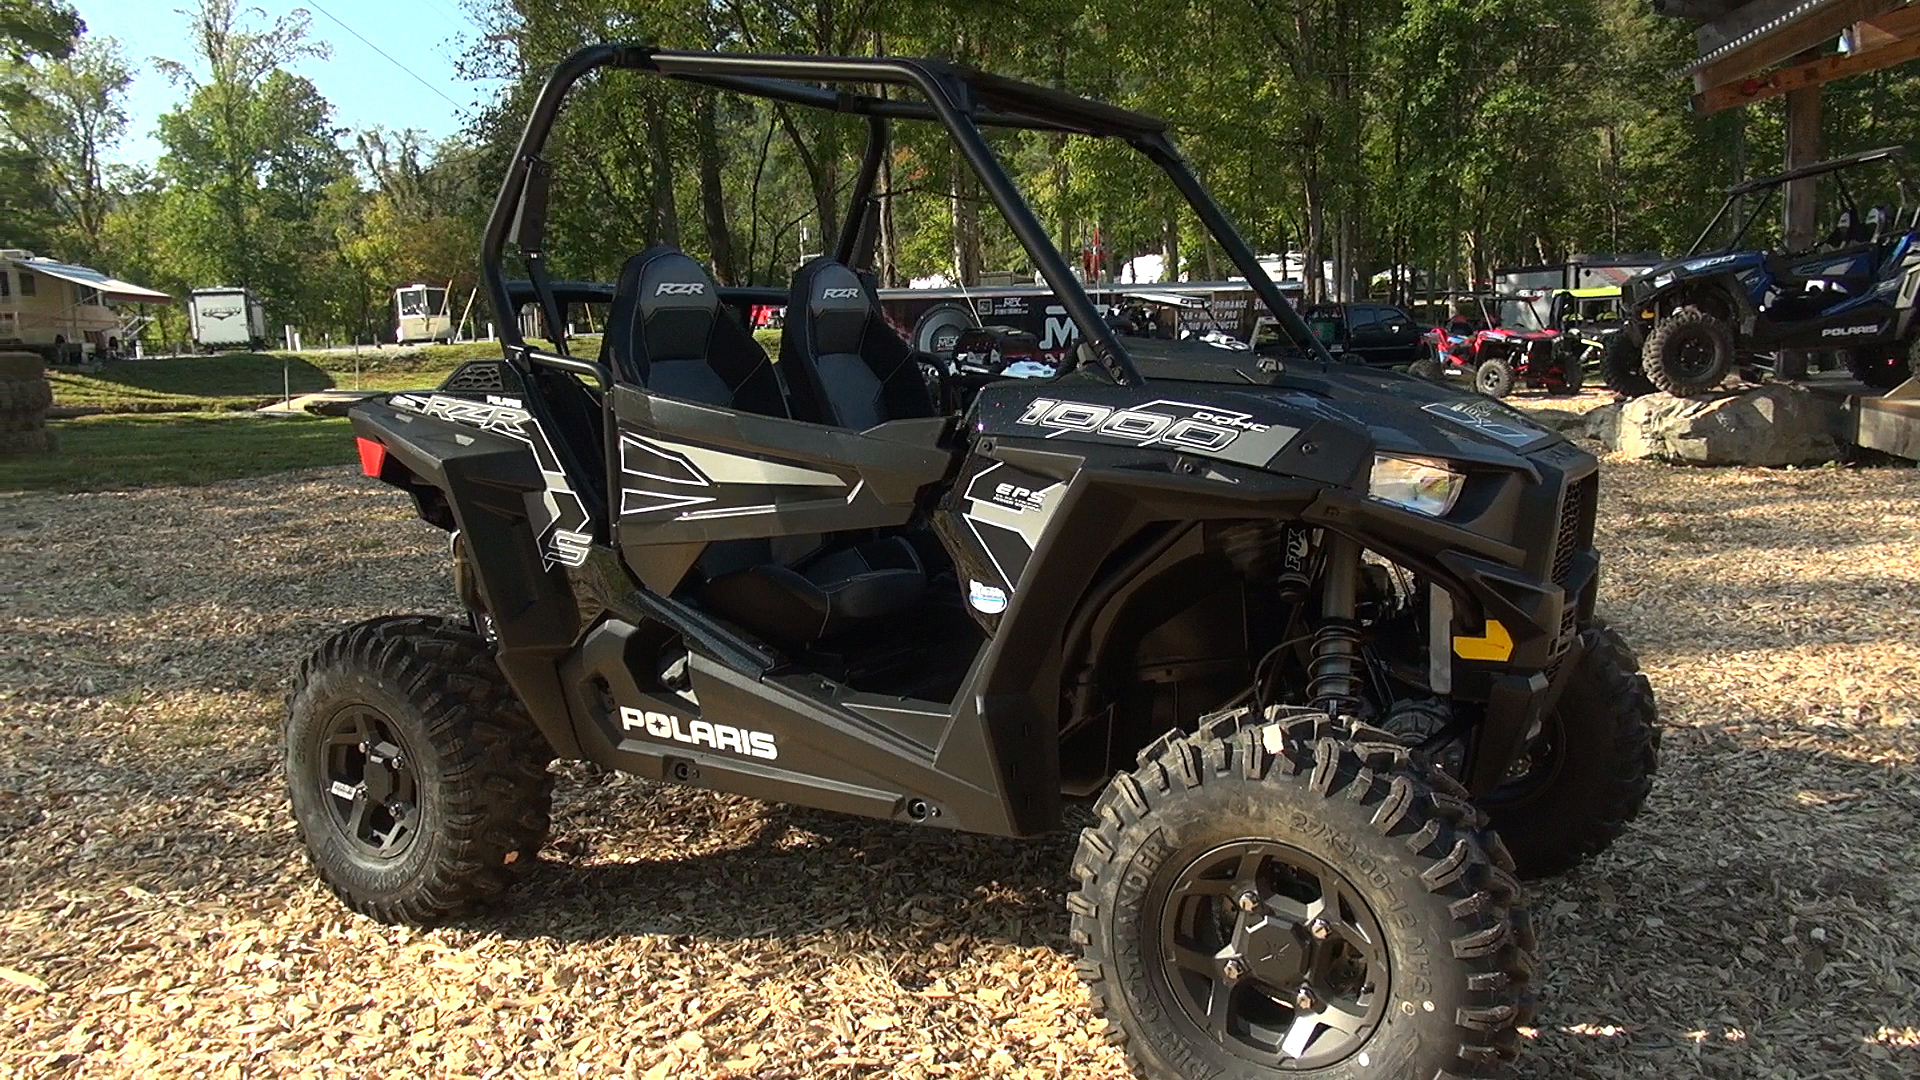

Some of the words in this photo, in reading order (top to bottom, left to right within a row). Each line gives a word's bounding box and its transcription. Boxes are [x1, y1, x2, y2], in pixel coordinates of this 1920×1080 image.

[655, 283, 704, 296] RZR
[823, 288, 858, 299] RZR
[1822, 324, 1878, 338] POLARIS
[422, 396, 532, 435] RZR
[1015, 397, 1241, 453] 1000
[1192, 411, 1271, 433] DOHC
[995, 482, 1044, 504] EPS
[544, 528, 594, 569] S
[1285, 528, 1309, 571] FOX
[619, 705, 779, 761] POLARIS
